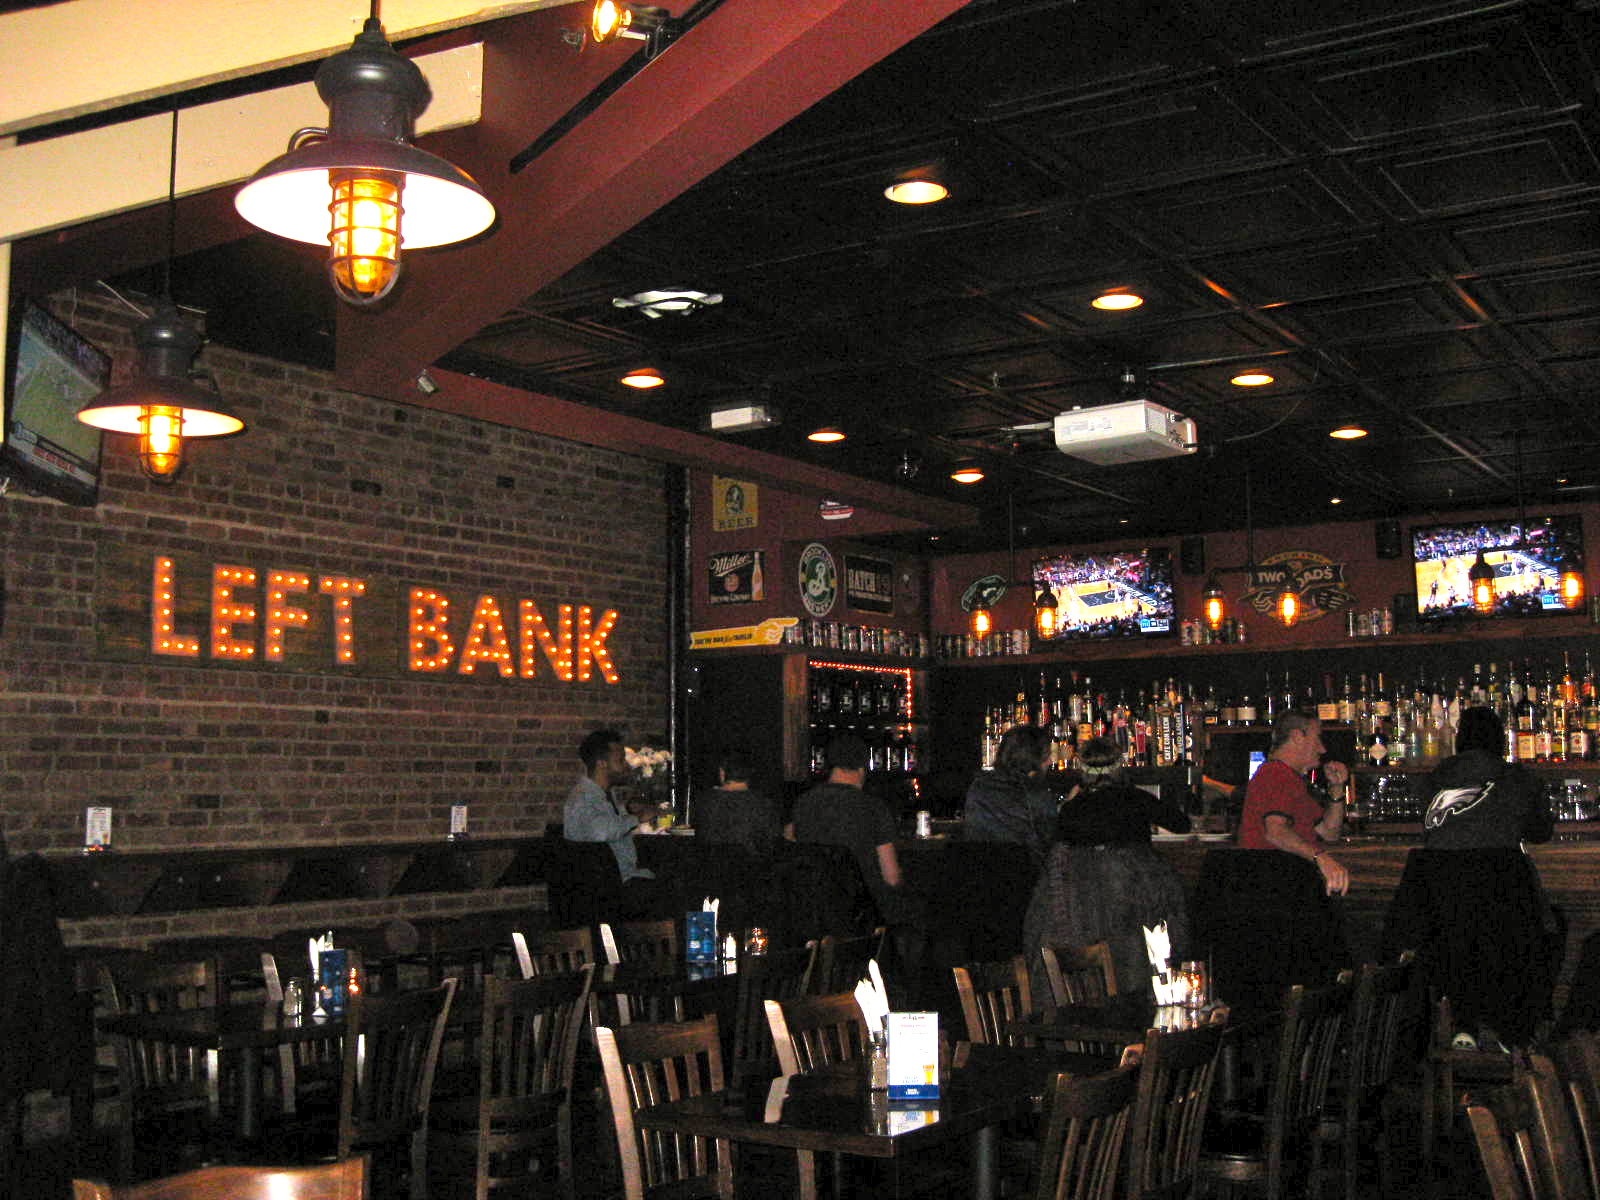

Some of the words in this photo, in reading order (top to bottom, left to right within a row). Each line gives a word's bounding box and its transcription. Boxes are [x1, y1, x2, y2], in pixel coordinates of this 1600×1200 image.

[709, 552, 753, 577] Miller
[1256, 571, 1287, 583] TWO
[151, 556, 366, 665] LEFT
[408, 586, 620, 684] BANK
